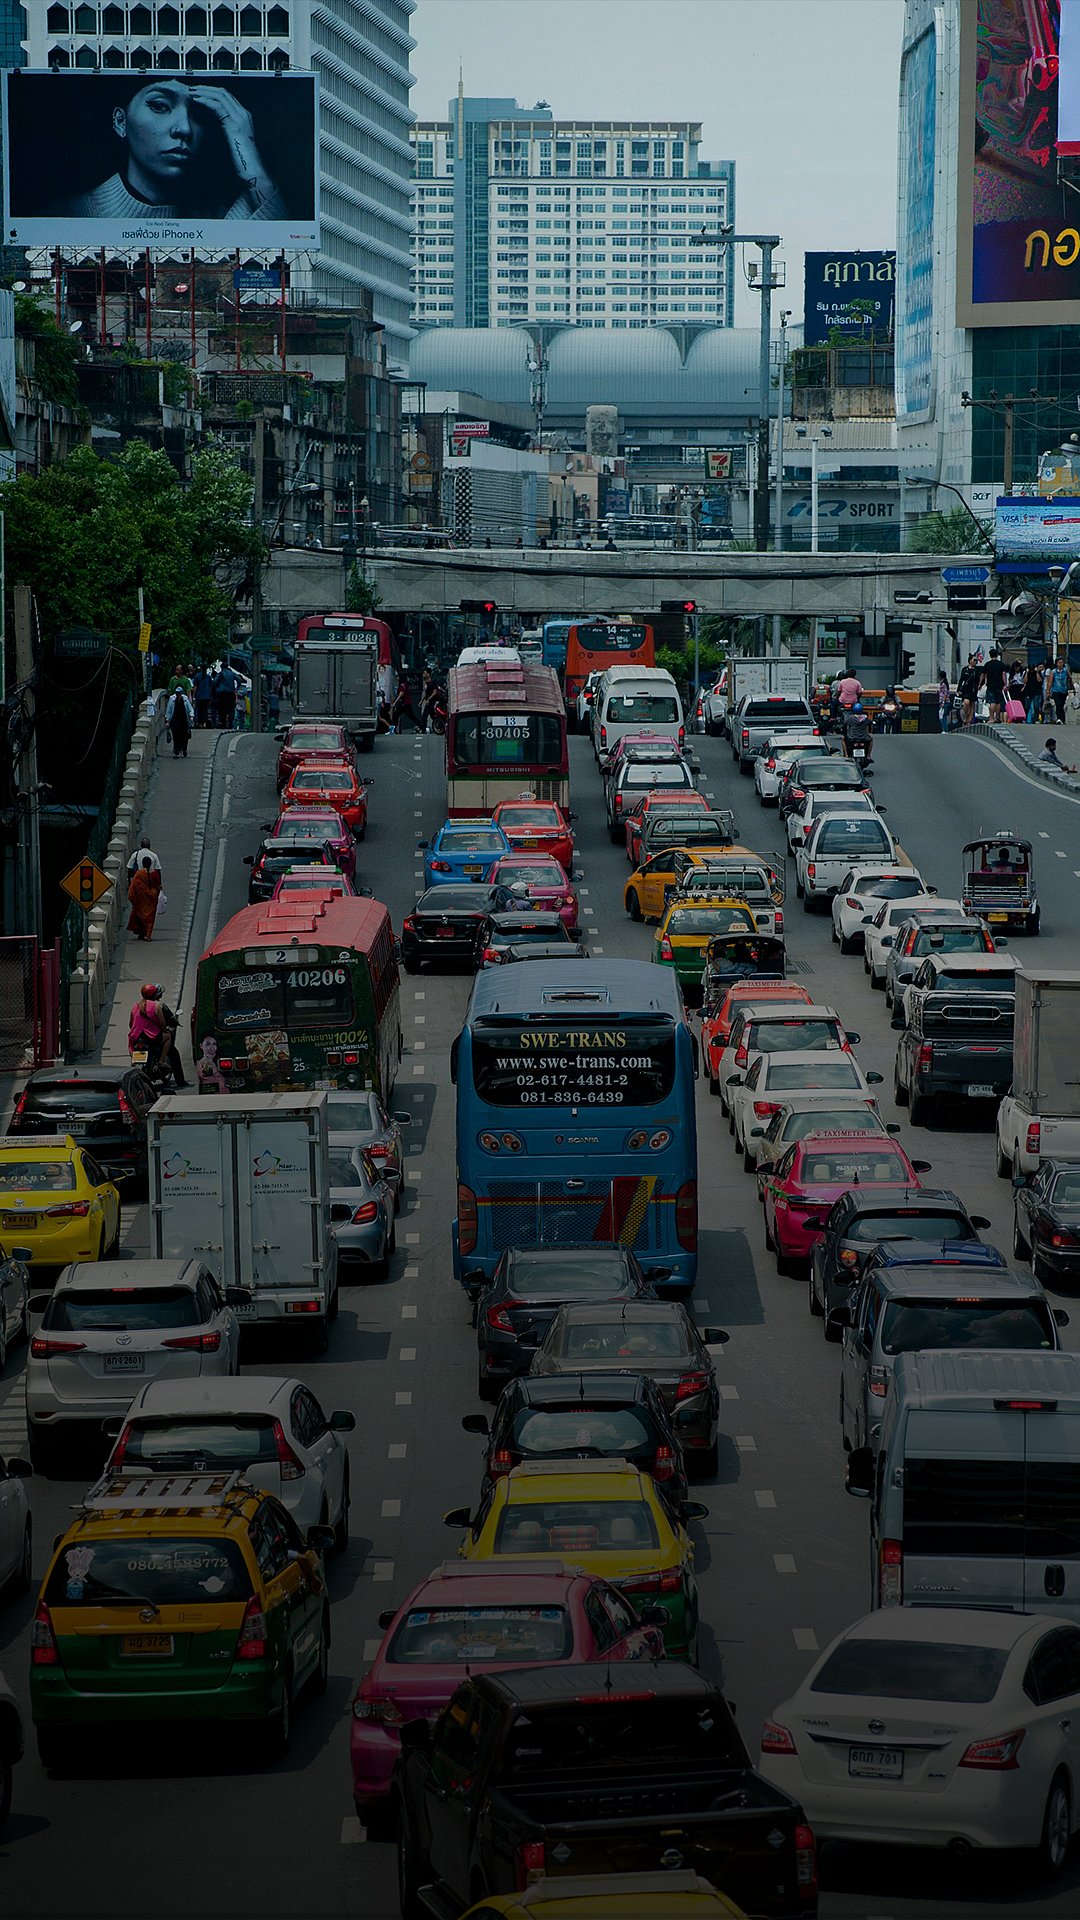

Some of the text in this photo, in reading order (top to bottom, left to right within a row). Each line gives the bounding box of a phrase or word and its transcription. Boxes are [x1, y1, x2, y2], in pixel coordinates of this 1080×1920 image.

[122, 227, 203, 239] เซลฟี่ด้วย iPhone X
[823, 256, 896, 288] ศุภาลั
[875, 302, 881, 310] 9
[850, 503, 894, 517] SPORT
[1002, 515, 1019, 523] VISA
[606, 626, 617, 634] 14
[504, 717, 516, 725] 13
[276, 951, 286, 963] 2
[287, 969, 346, 988] 40206
[335, 1030, 368, 1044] 100%
[520, 1032, 626, 1048] SWE-TRANS
[497, 1055, 652, 1069] www.swe-trans.com
[516, 1075, 628, 1086] 02-617-4481-2
[520, 1092, 624, 1103] 081-836-6439
[145, 1635, 170, 1646] 3725
[879, 1753, 897, 1764] 701
